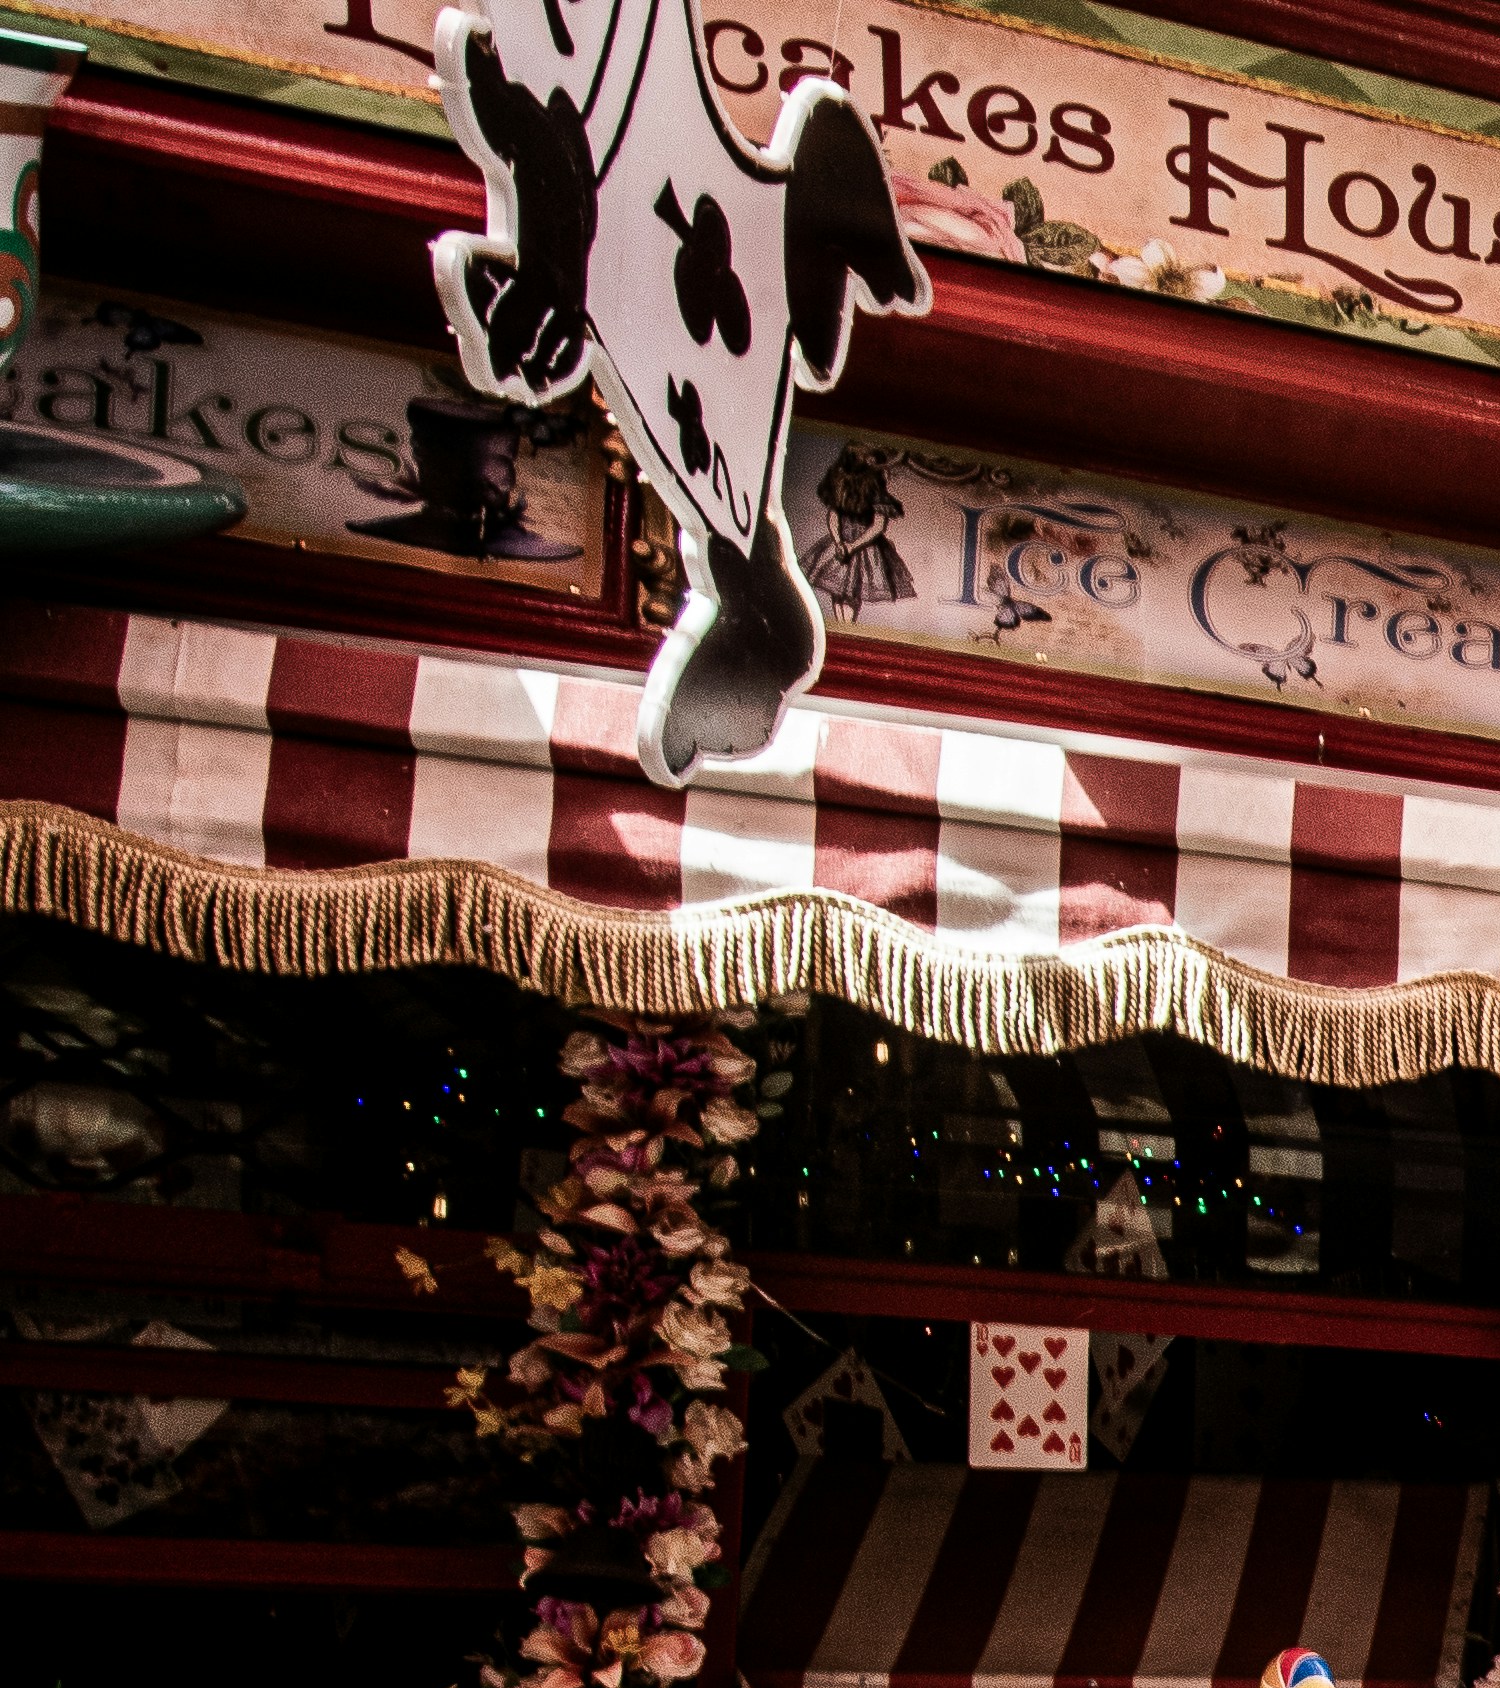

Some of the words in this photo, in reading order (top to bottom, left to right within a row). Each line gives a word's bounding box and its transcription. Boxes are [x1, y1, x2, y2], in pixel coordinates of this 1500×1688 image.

[0, 358, 404, 480] akes
[712, 442, 751, 536] 2
[947, 500, 1141, 606] Ice
[976, 1323, 989, 1341] 10
